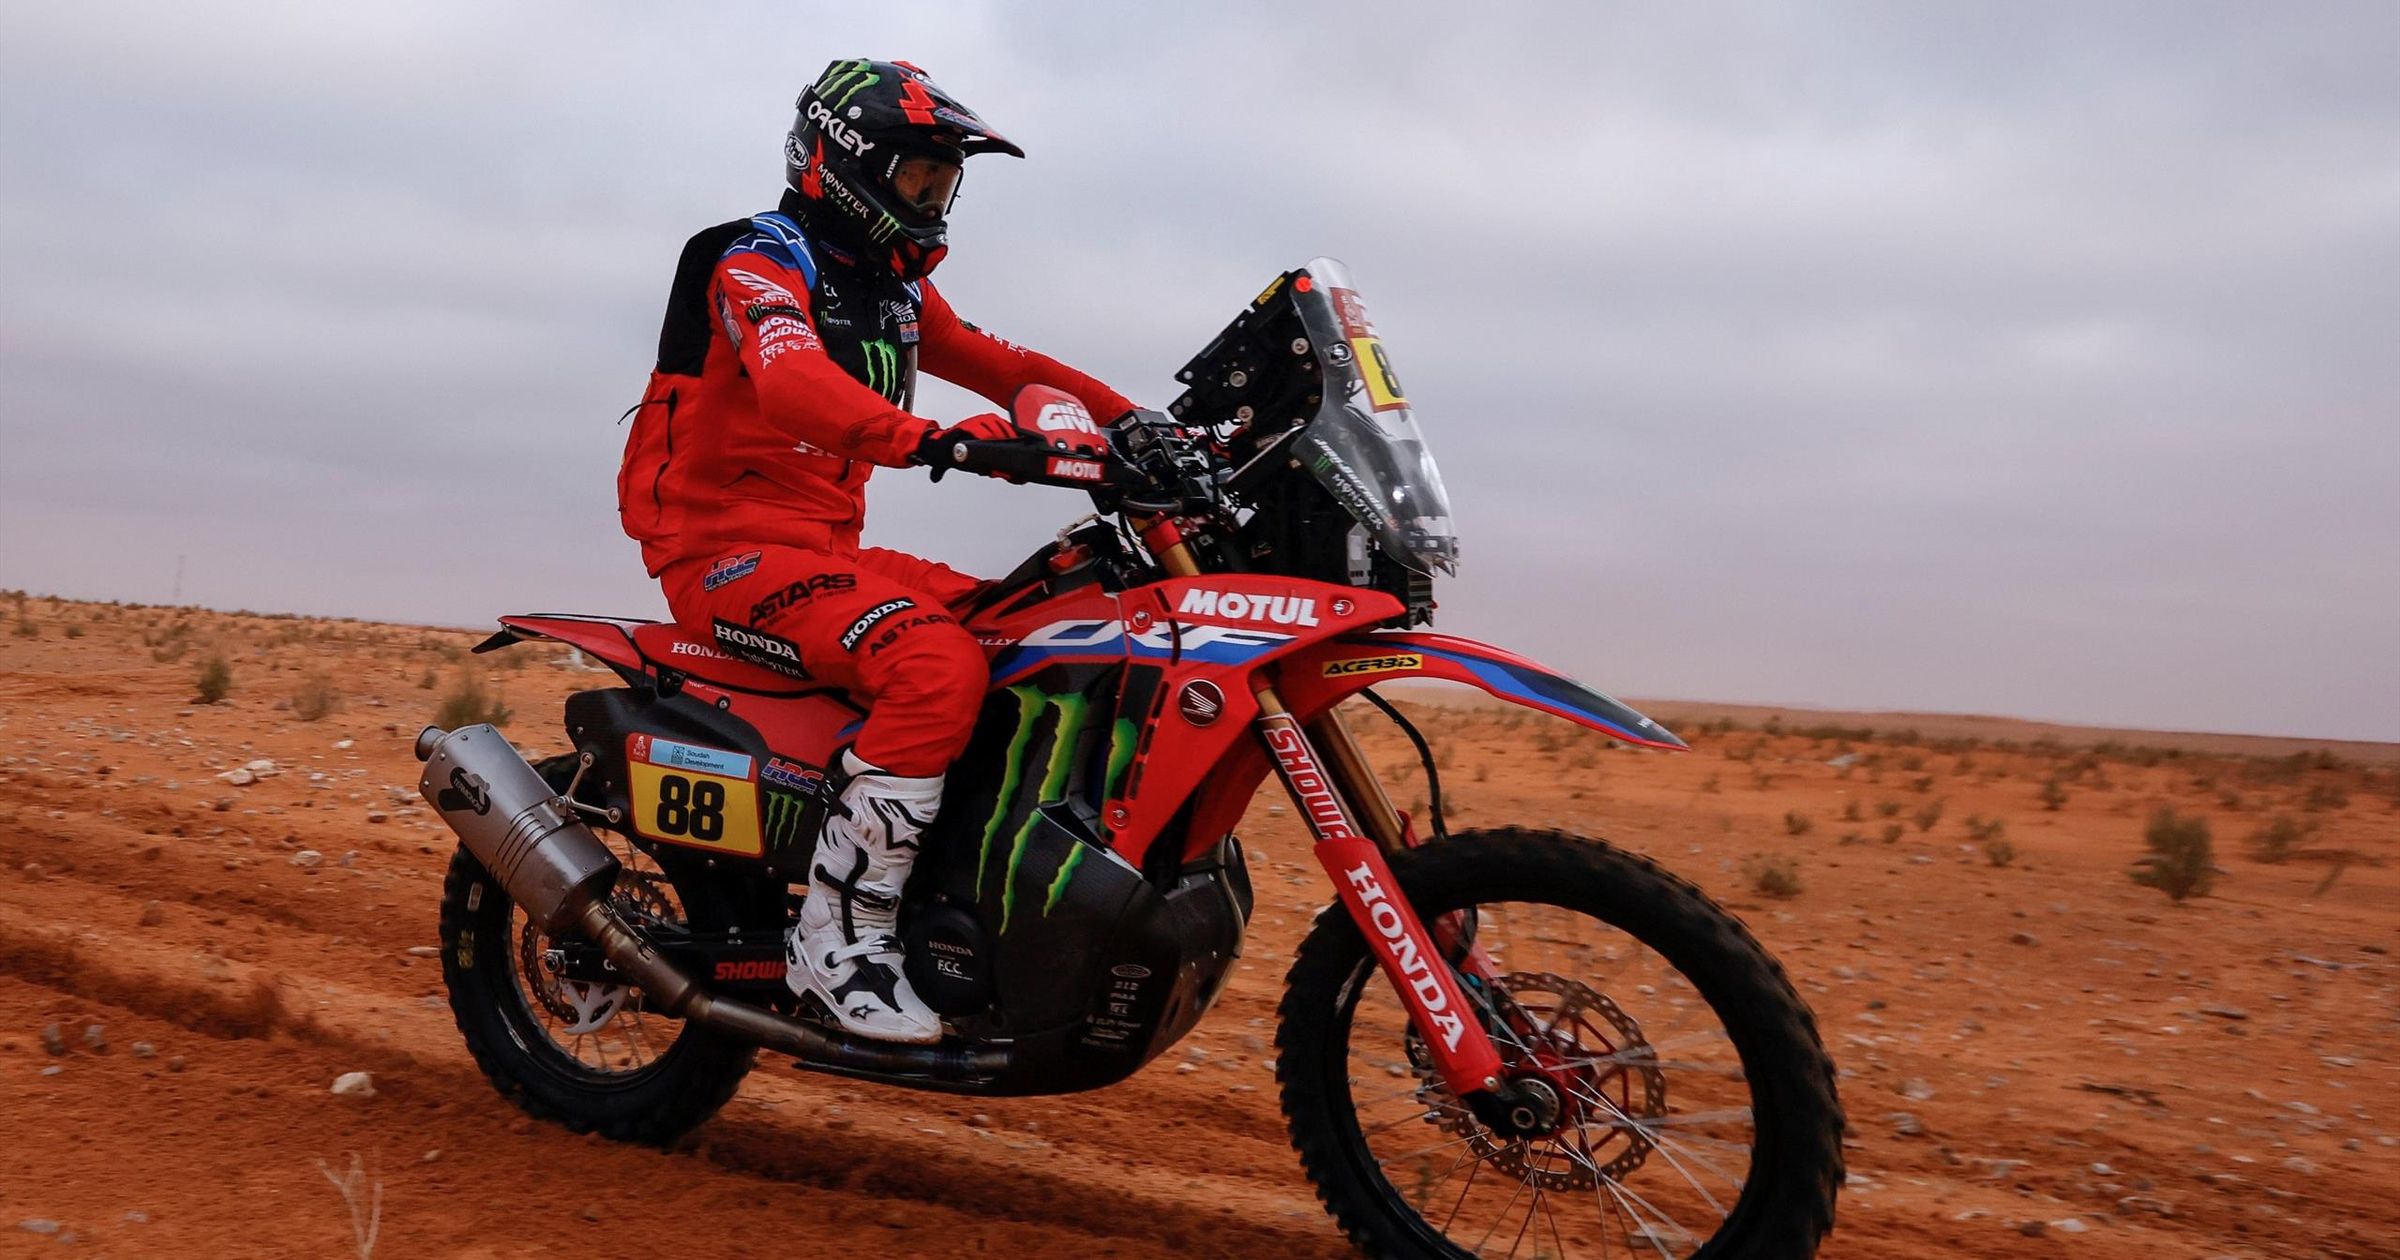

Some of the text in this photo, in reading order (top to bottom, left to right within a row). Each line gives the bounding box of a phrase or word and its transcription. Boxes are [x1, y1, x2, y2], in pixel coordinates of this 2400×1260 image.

[807, 101, 875, 158] OAKLEY
[817, 163, 870, 219] MONSTER
[750, 573, 857, 627] ASTARS
[841, 600, 916, 650] HONDA
[1179, 589, 1320, 628] MOTUL
[714, 623, 800, 661] HONDA
[1325, 657, 1419, 675] ACERBIS
[762, 757, 824, 791] HRC
[656, 774, 725, 841] 88
[928, 940, 974, 957] HONDA
[1345, 861, 1466, 1053] HONDA
